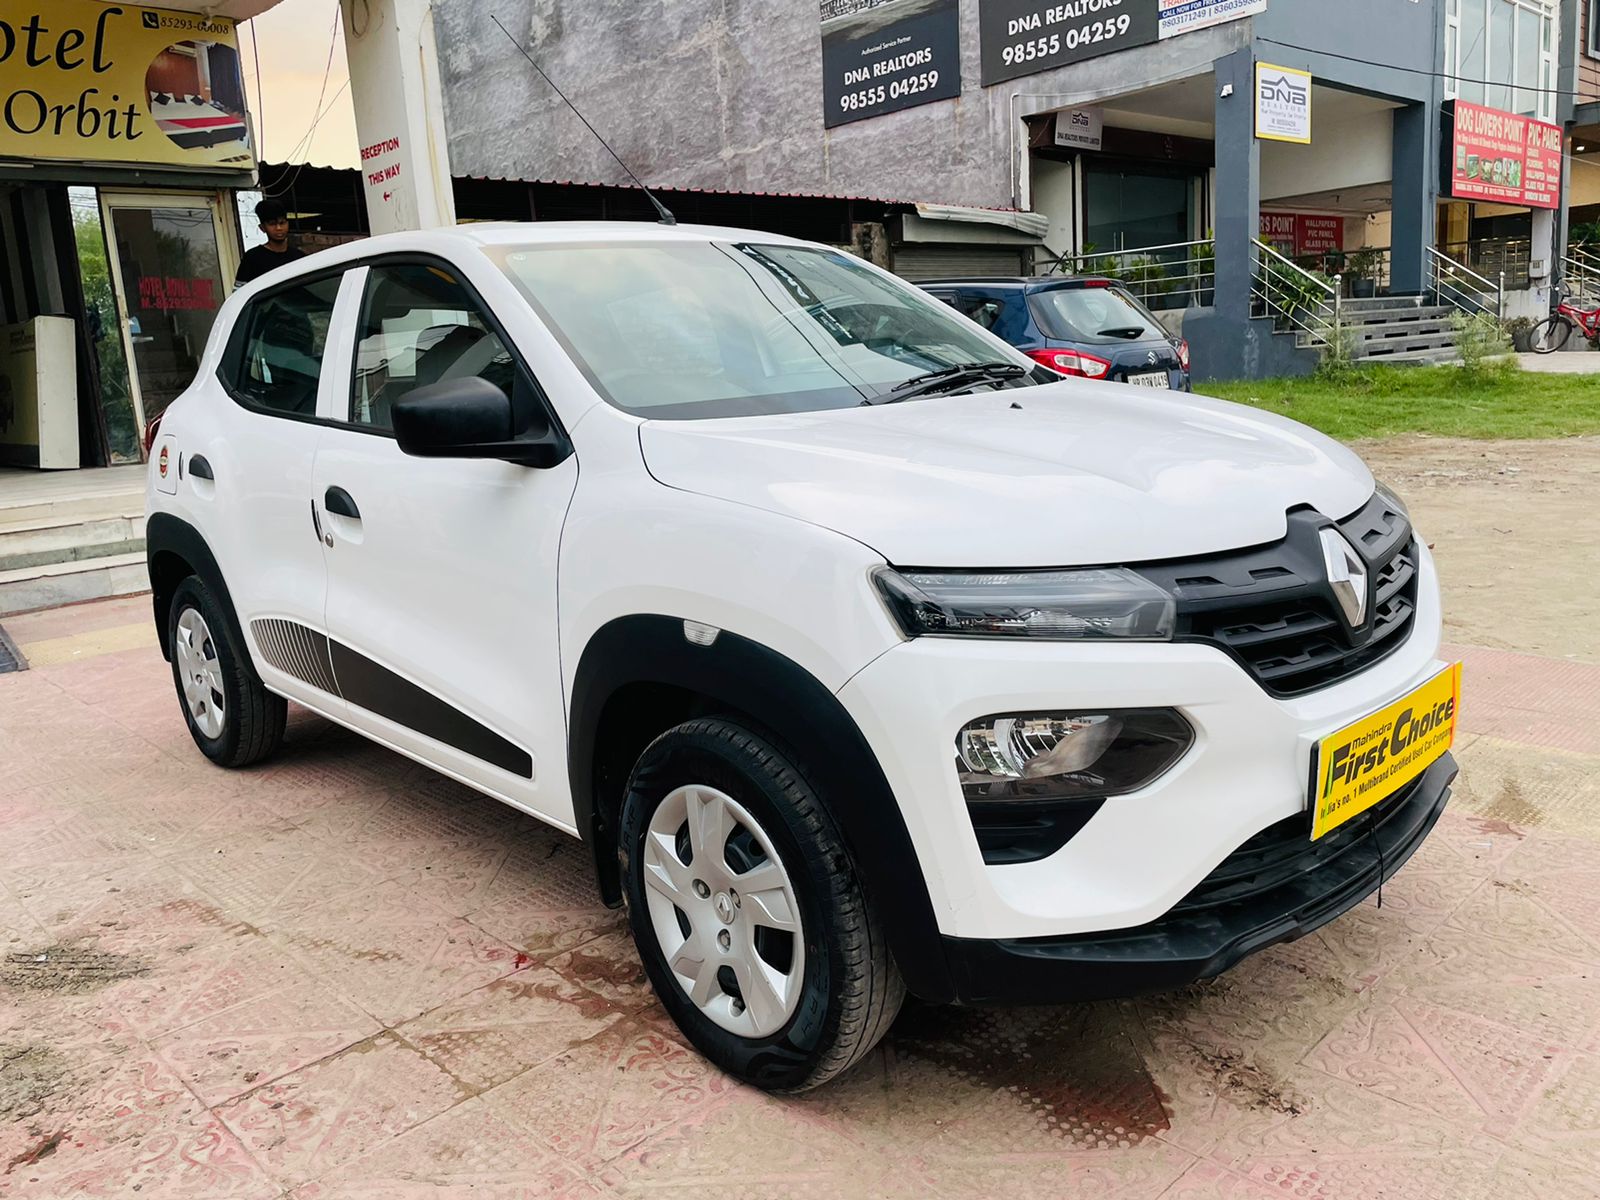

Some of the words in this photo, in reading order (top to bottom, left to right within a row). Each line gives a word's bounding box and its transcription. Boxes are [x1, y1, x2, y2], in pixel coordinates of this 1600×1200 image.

[1008, 13, 1041, 36] DNA
[1162, 9, 1176, 18] CALL
[1176, 4, 1190, 13] NOW
[1002, 34, 1060, 66] 98555
[1066, 14, 1131, 50] 04259
[844, 67, 870, 86] DNA
[873, 47, 932, 77] REALTORS
[840, 85, 886, 112] 98555
[889, 70, 939, 99] 04259
[4, 88, 143, 140] Orbit
[1457, 106, 1473, 132] DOG
[1504, 117, 1524, 144] POINT
[361, 136, 399, 160] RECEPTION
[1527, 122, 1541, 147] PVC
[1542, 126, 1561, 152] PANEL
[368, 170, 384, 186] THIS
[384, 162, 400, 180] WAY
[1272, 216, 1294, 233] POINT
[1305, 219, 1337, 228] WALLPAPERS
[1307, 229, 1318, 238] PVC
[1318, 230, 1334, 238] PANEL
[1390, 697, 1455, 756] Choice
[1341, 794, 1352, 806] no.
[1353, 787, 1357, 798] 1
[1358, 767, 1389, 795] Multibrand
[1390, 751, 1412, 776] Certified
[1412, 743, 1424, 761] Used
[1424, 739, 1433, 752] Car
